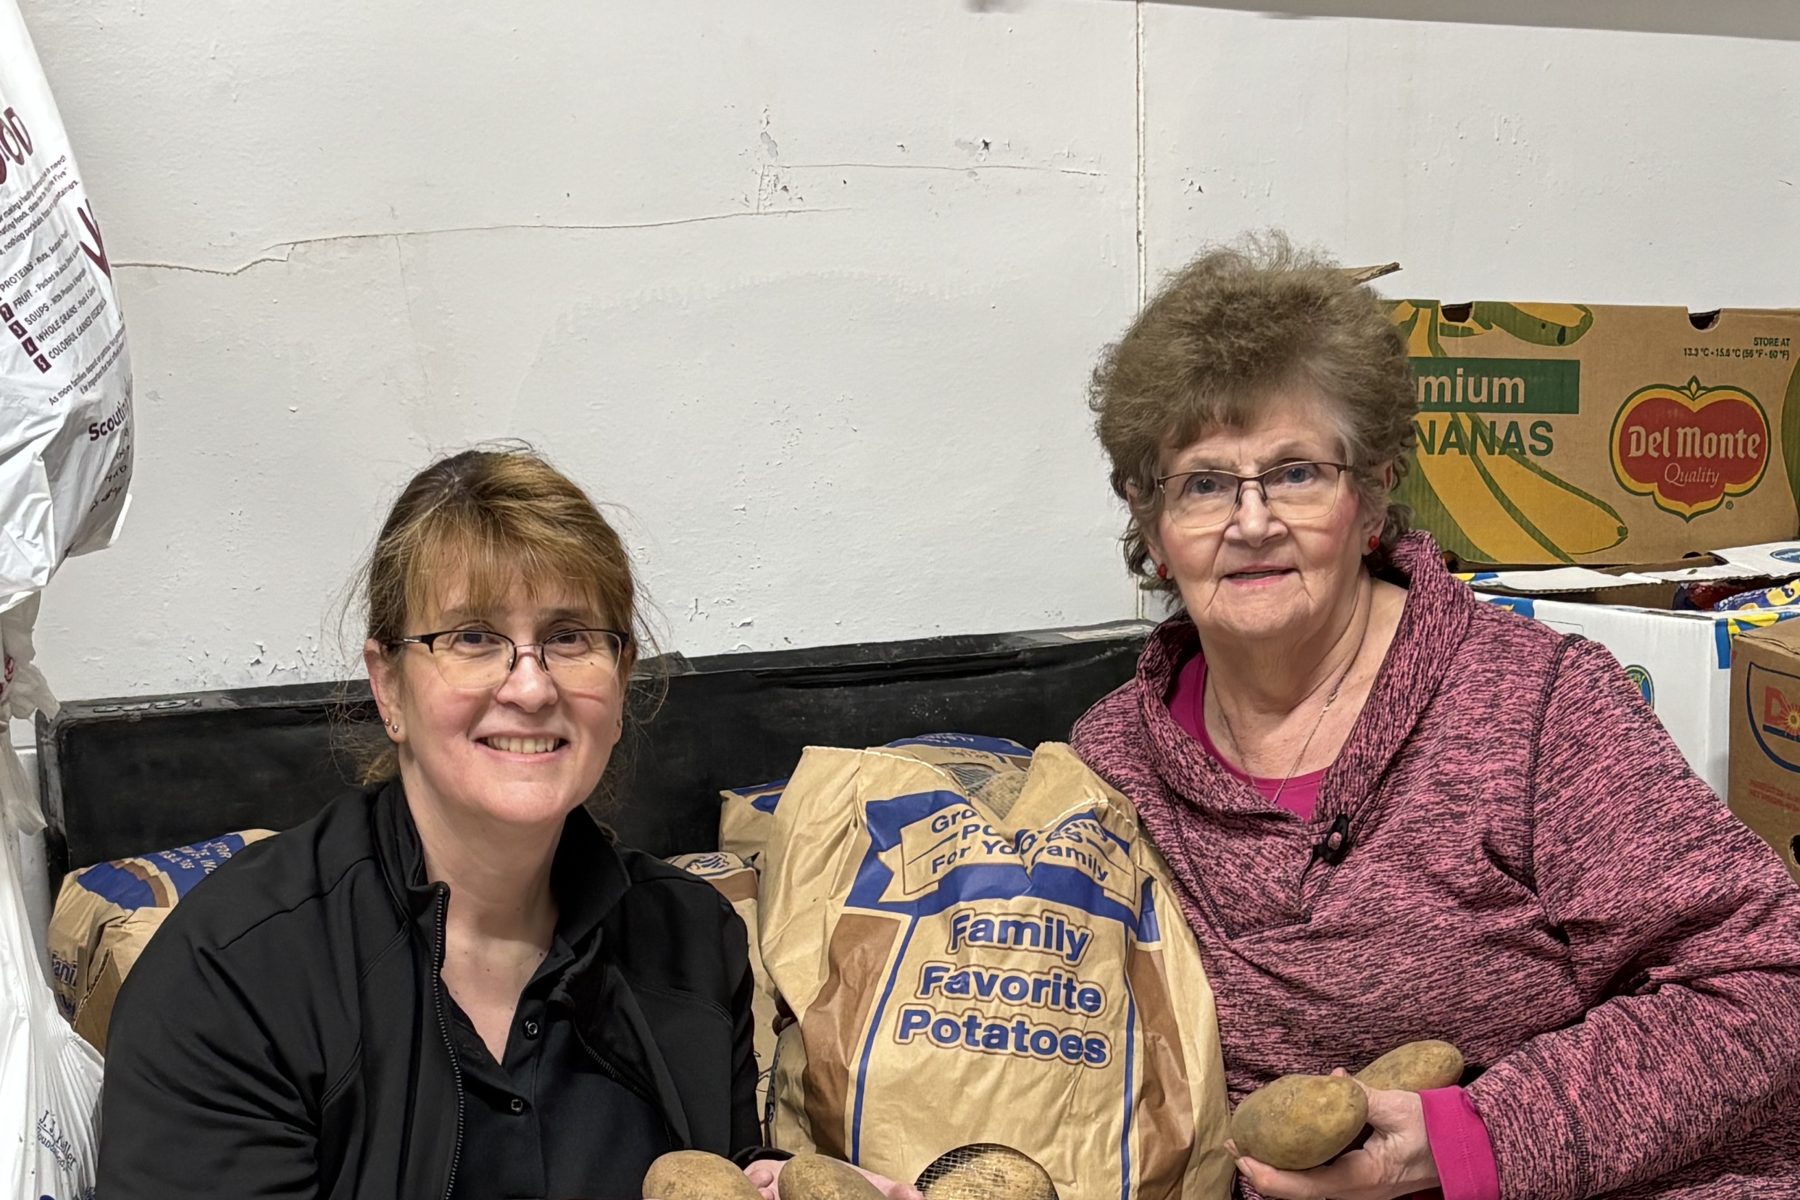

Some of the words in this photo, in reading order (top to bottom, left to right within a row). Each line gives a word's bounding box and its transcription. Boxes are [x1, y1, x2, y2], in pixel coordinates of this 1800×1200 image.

[13, 289, 32, 310] FRUIT
[24, 304, 50, 326] SOUPS
[36, 321, 61, 343] WHOLE
[1753, 336, 1779, 347] STORE
[1780, 338, 1791, 347] AT
[1627, 425, 1671, 459] Del
[1676, 426, 1761, 460] Monte
[1664, 462, 1720, 488] Quality
[932, 846, 971, 874] For
[948, 910, 1092, 964] Family
[917, 963, 1105, 1015] Favorite
[896, 1006, 1109, 1066] Potatoes
